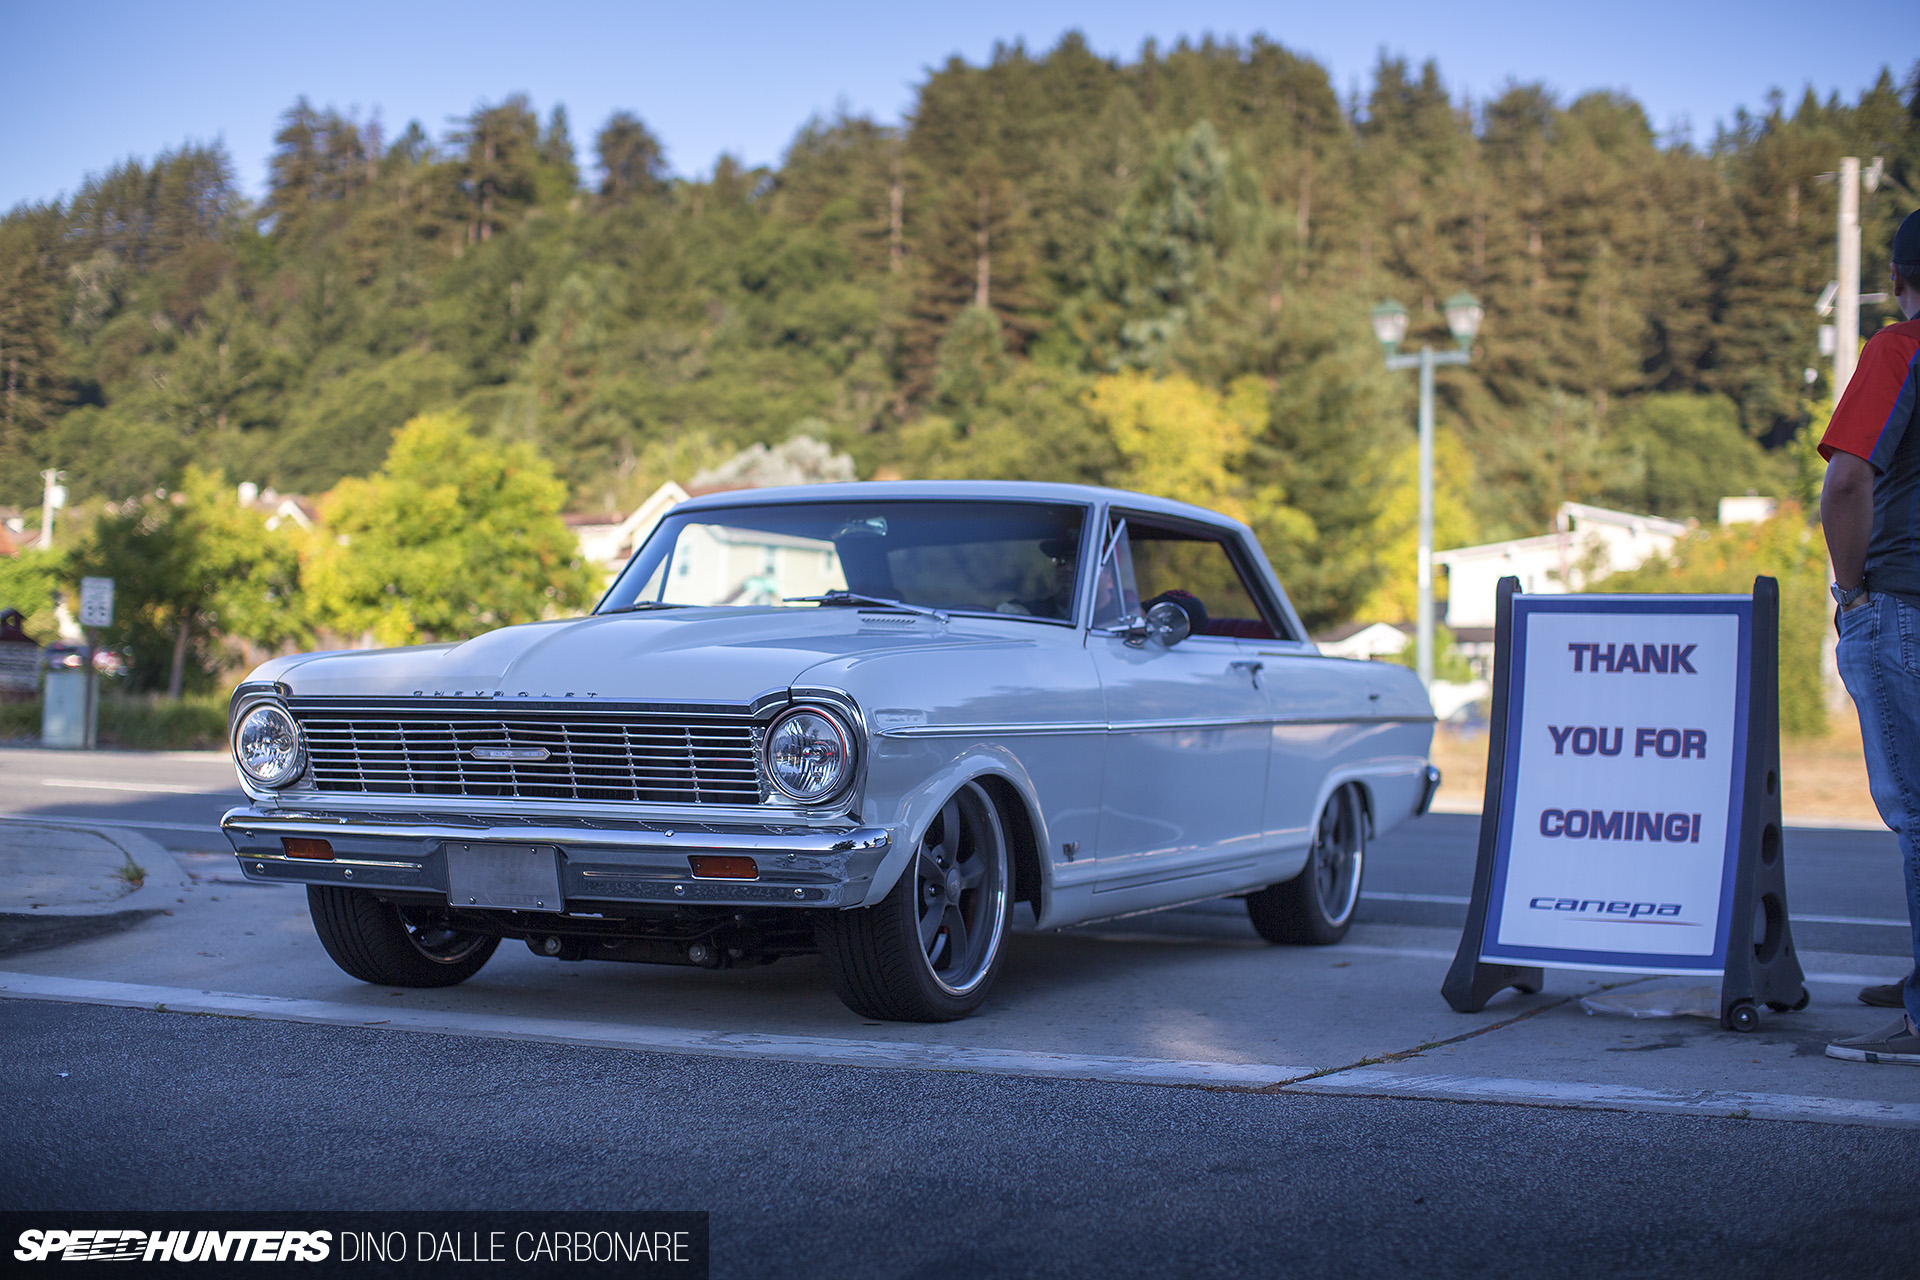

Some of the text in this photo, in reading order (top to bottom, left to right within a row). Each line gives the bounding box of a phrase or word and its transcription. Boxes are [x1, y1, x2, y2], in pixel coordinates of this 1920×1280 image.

[1568, 643, 1698, 674] THANK
[1548, 725, 1707, 759] YOU FOR
[1540, 809, 1702, 843] COMING!
[1529, 896, 1683, 918] canepa
